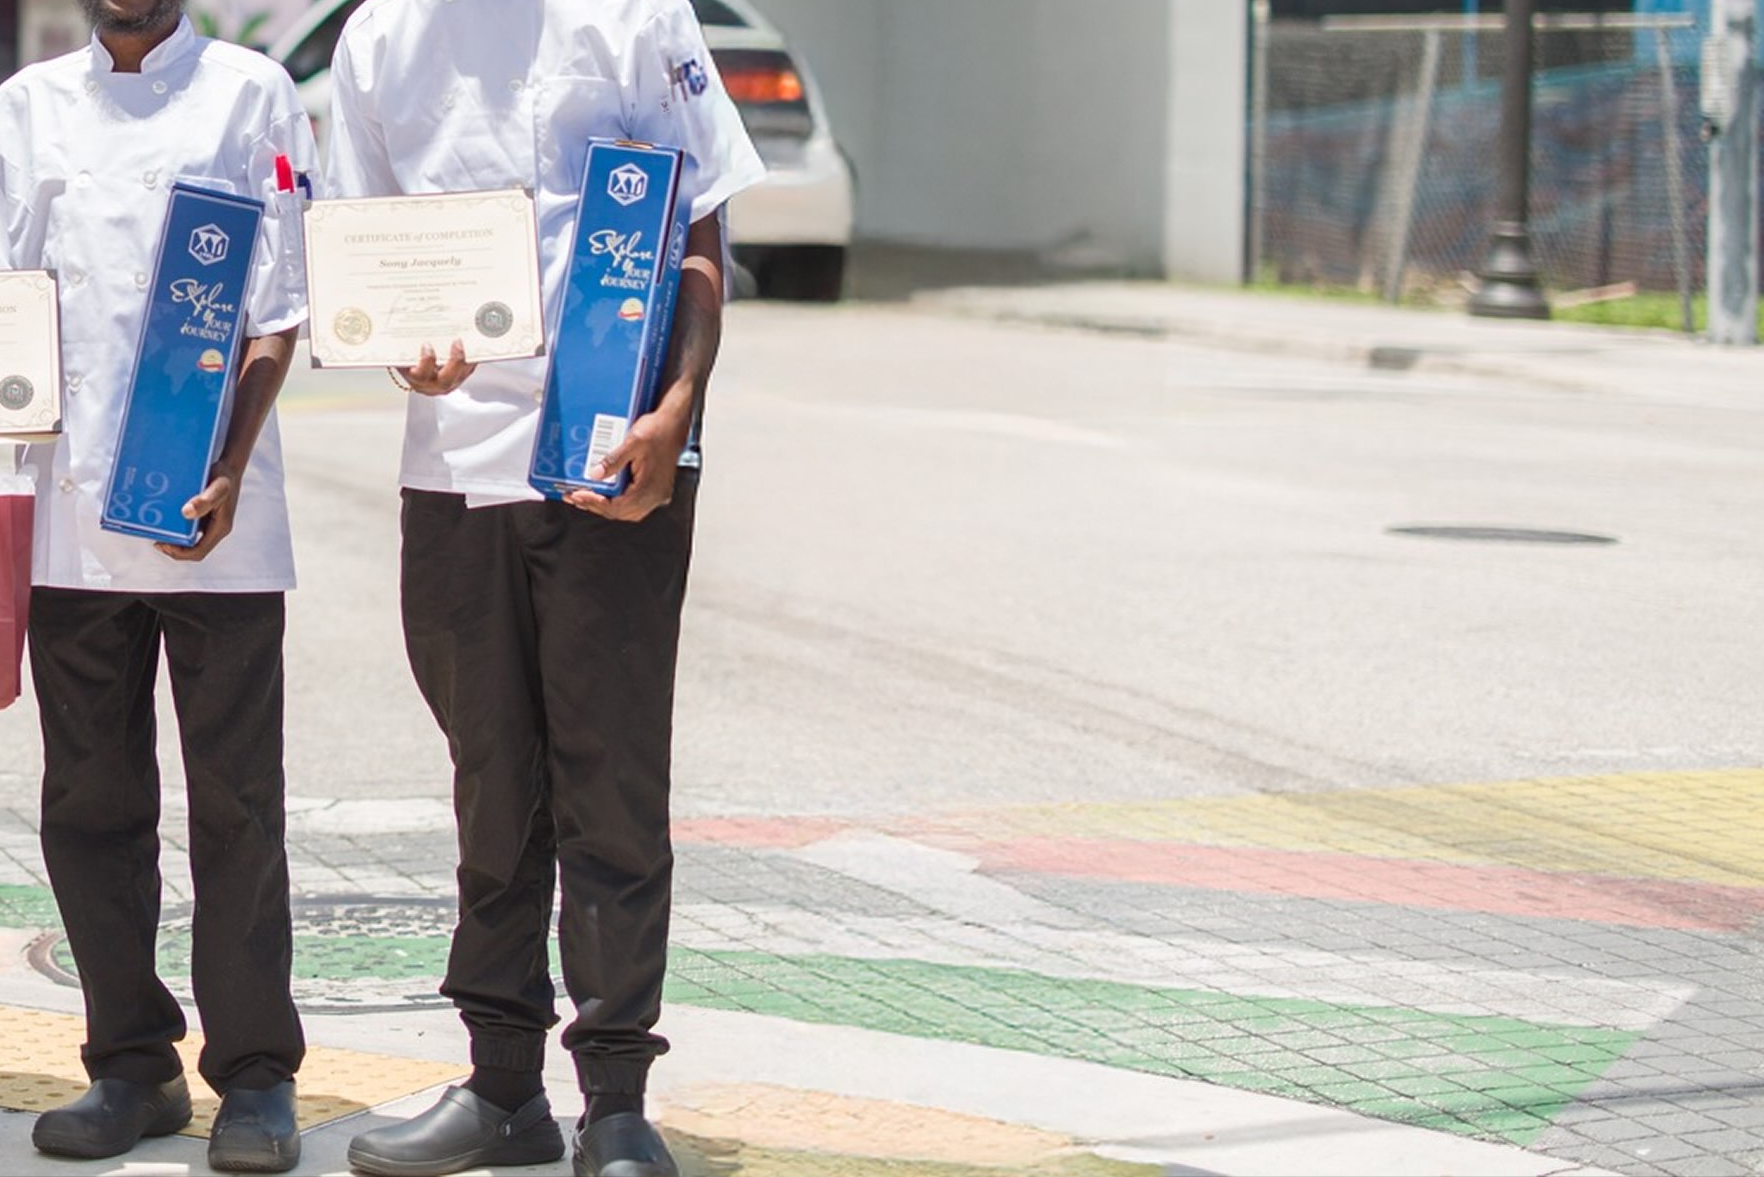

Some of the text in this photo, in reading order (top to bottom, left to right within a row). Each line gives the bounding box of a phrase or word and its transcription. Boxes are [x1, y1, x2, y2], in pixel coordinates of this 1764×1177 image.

[344, 228, 494, 244] CERTIFICATE of COMPLETION
